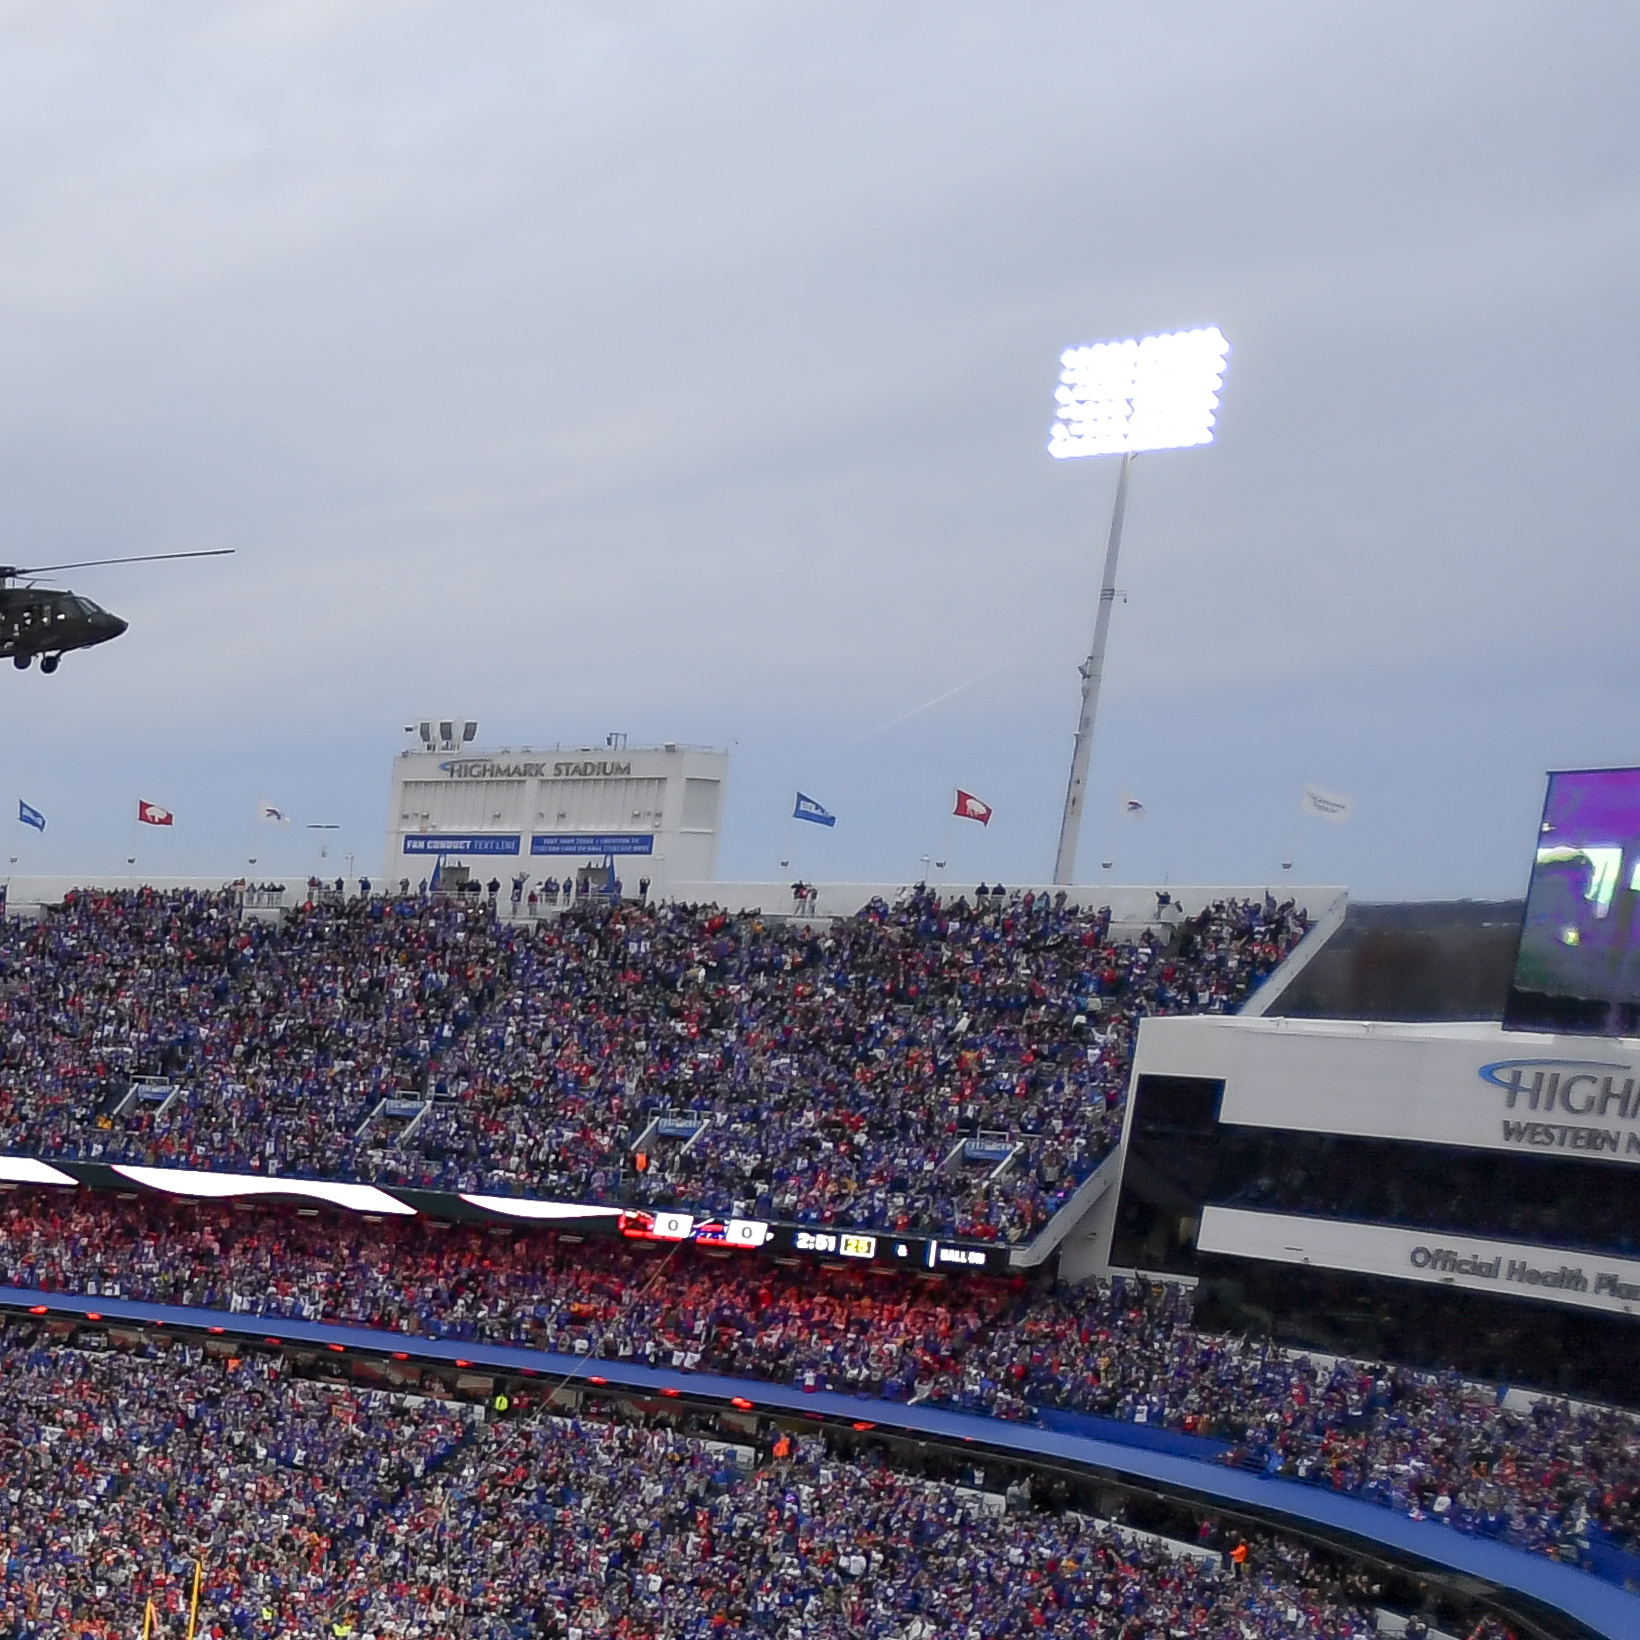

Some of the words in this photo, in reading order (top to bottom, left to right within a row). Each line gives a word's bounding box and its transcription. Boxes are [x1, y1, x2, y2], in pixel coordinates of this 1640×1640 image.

[449, 762, 546, 778] HIGHMARK
[553, 761, 632, 777] STADIUM
[1502, 1119, 1621, 1153] WESTERN
[667, 1218, 680, 1232] 0
[741, 1225, 753, 1240] 0
[796, 1232, 837, 1252] 2:51
[1410, 1246, 1502, 1279] Official
[1506, 1259, 1588, 1293] Health
